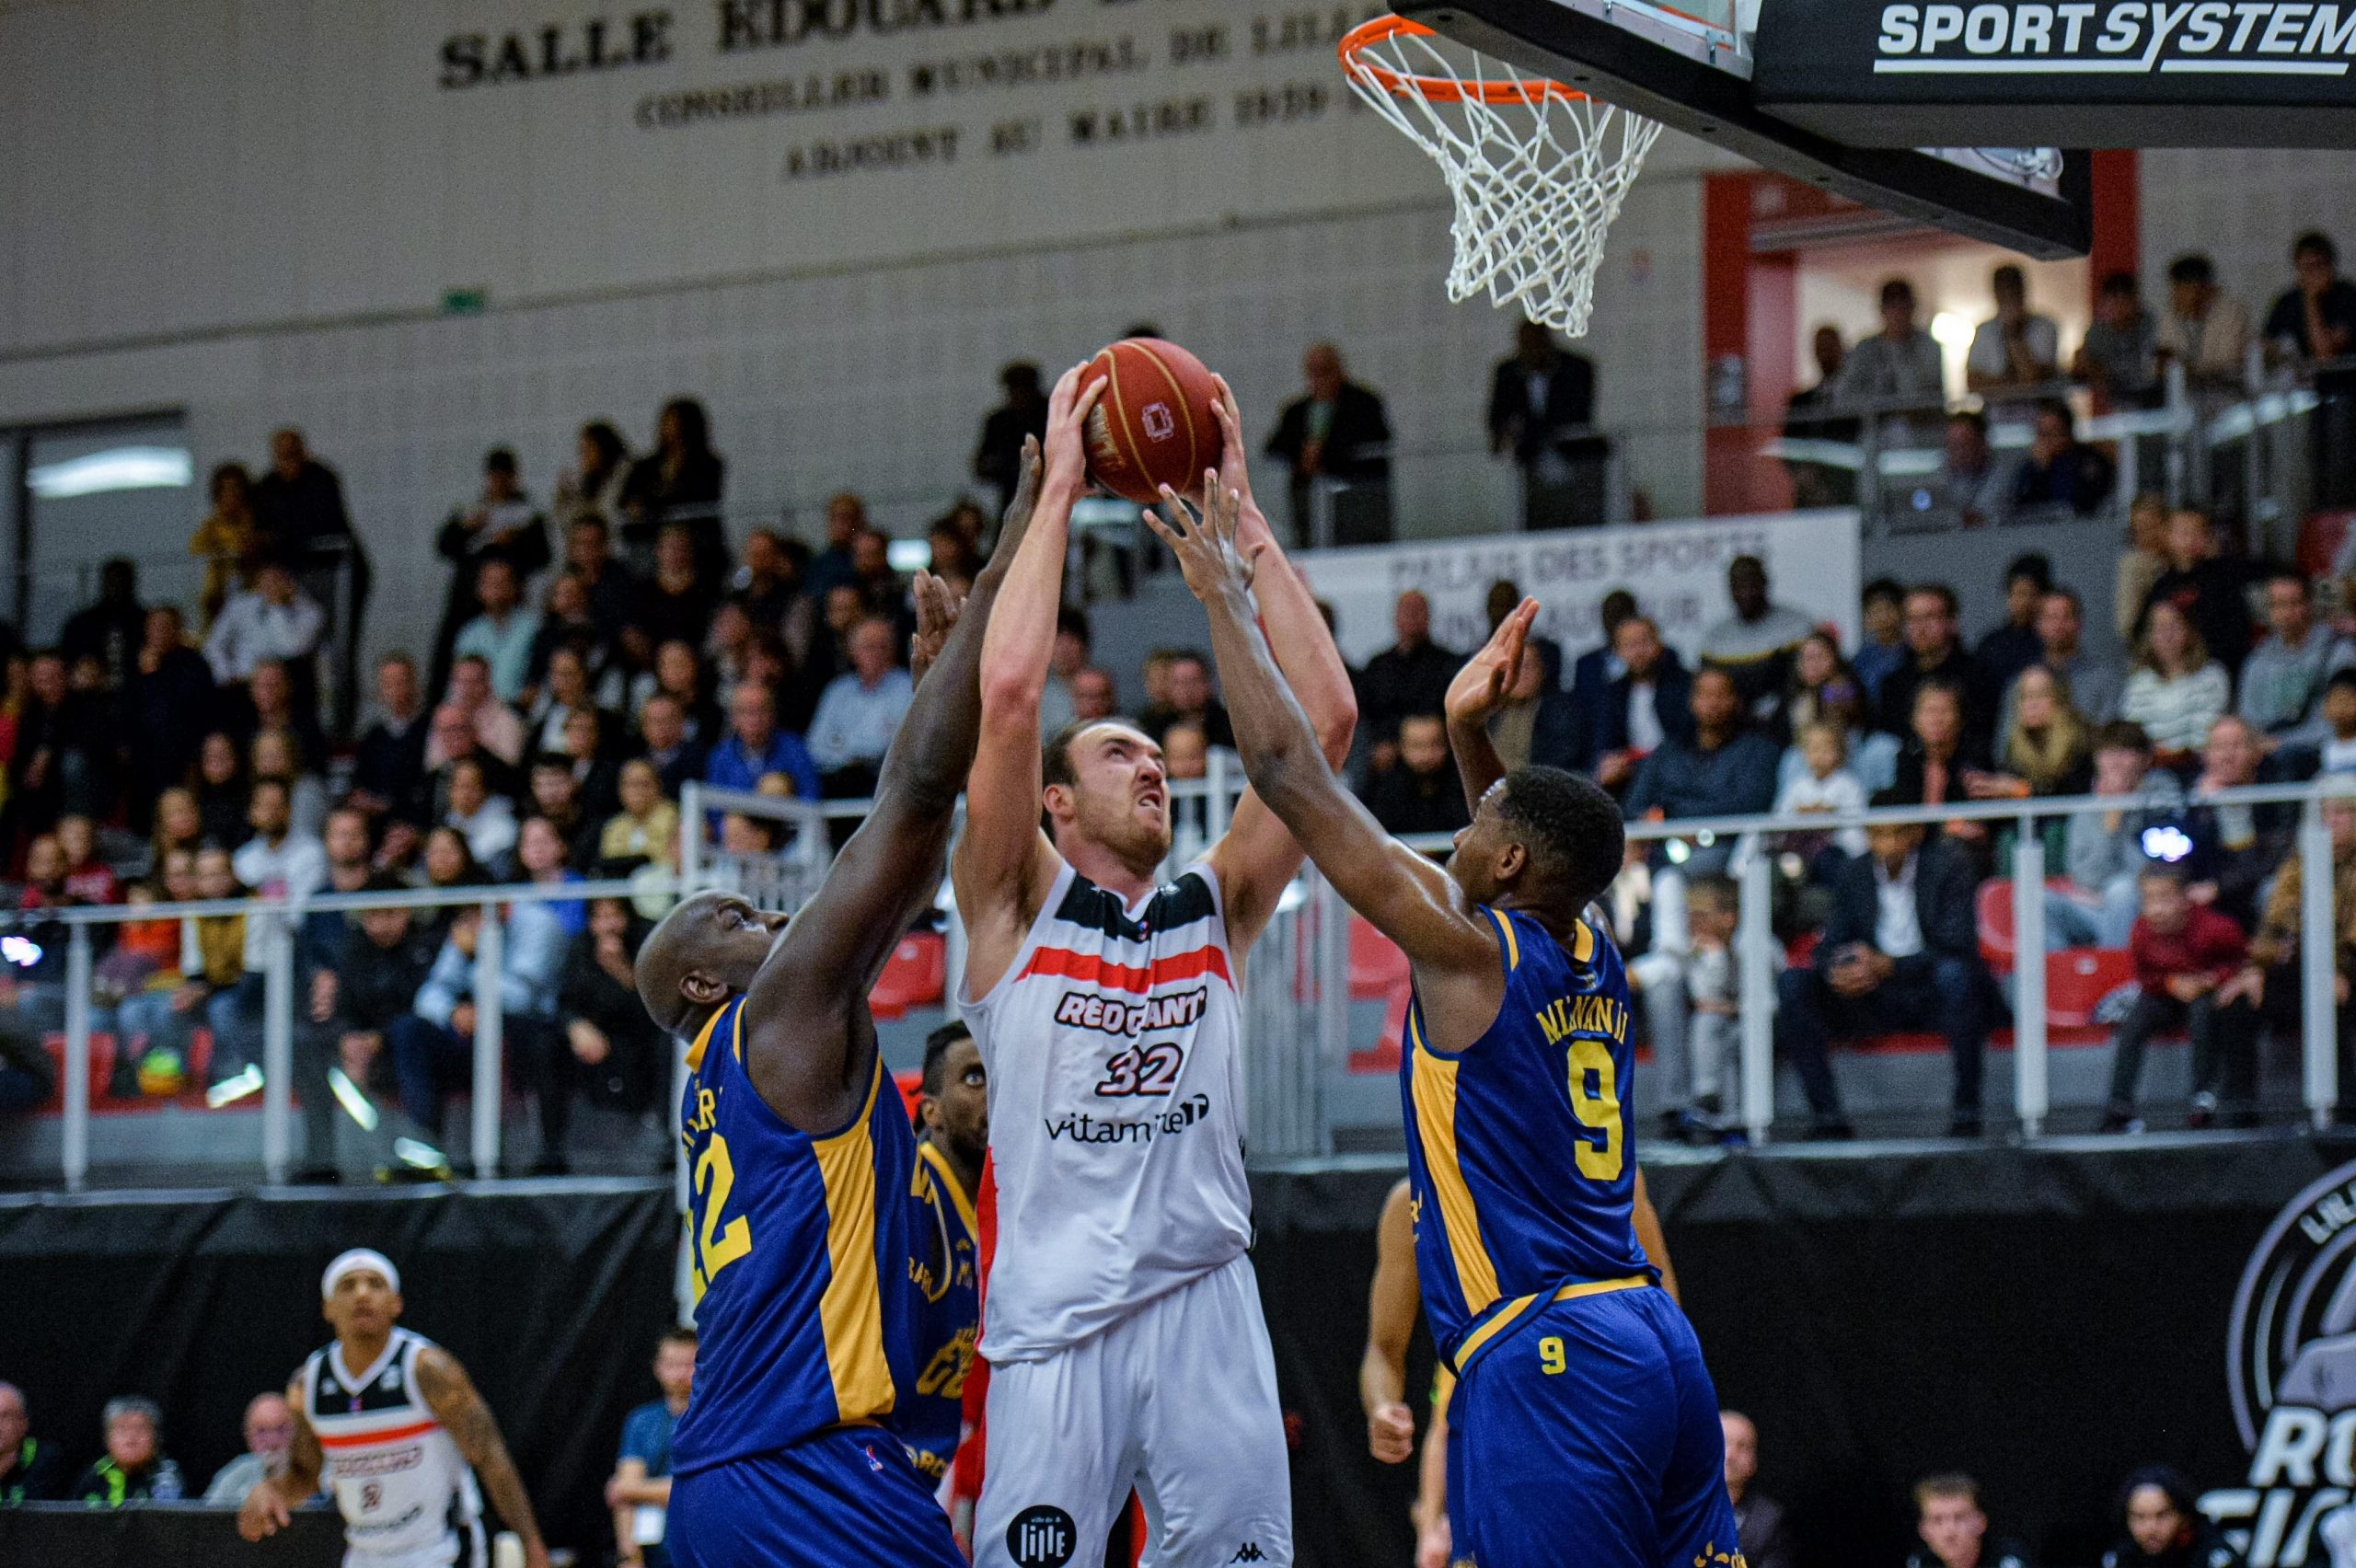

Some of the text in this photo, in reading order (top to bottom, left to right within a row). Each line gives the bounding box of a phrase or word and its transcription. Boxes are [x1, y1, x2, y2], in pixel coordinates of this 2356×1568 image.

[437, 10, 673, 89] SALLE
[1527, 544, 1605, 583] DES
[1095, 1042, 1183, 1096] 32
[1566, 1041, 1623, 1181] 9
[1539, 1337, 1566, 1375] 9
